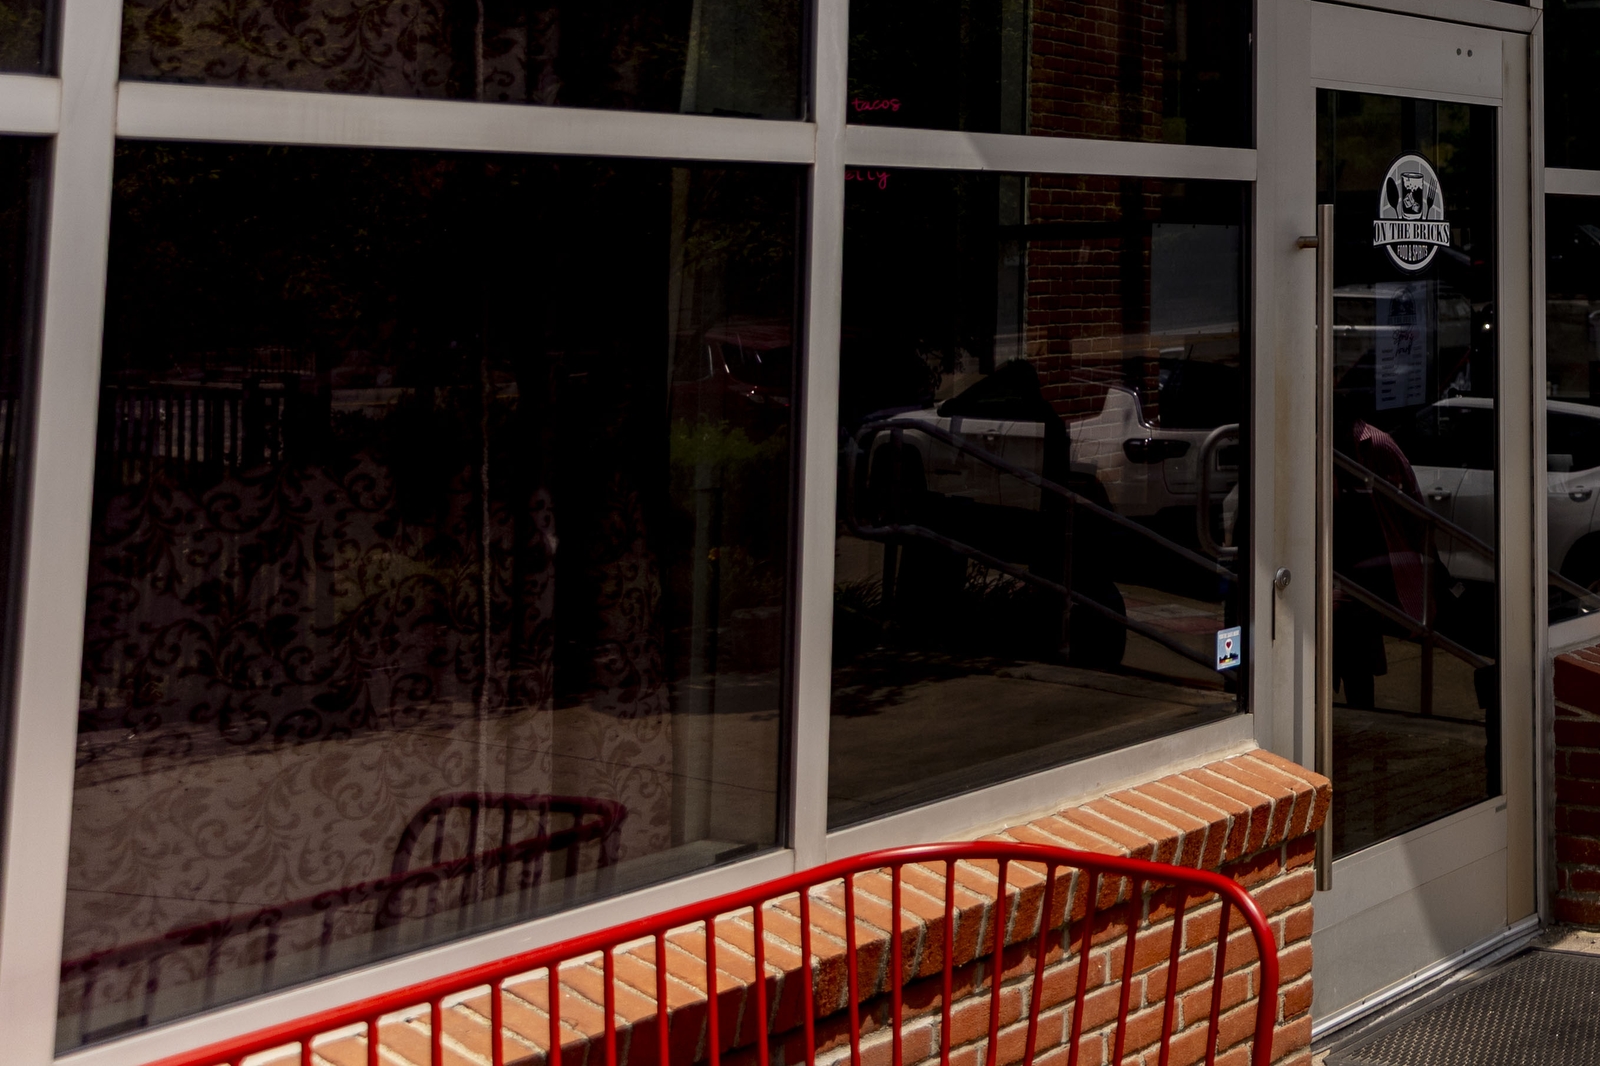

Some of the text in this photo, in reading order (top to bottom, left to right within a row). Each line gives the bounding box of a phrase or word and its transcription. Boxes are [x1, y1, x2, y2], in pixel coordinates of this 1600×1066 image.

[851, 97, 902, 112] tacos
[845, 169, 892, 190] elly
[1374, 222, 1449, 243] ON THE BRICKS
